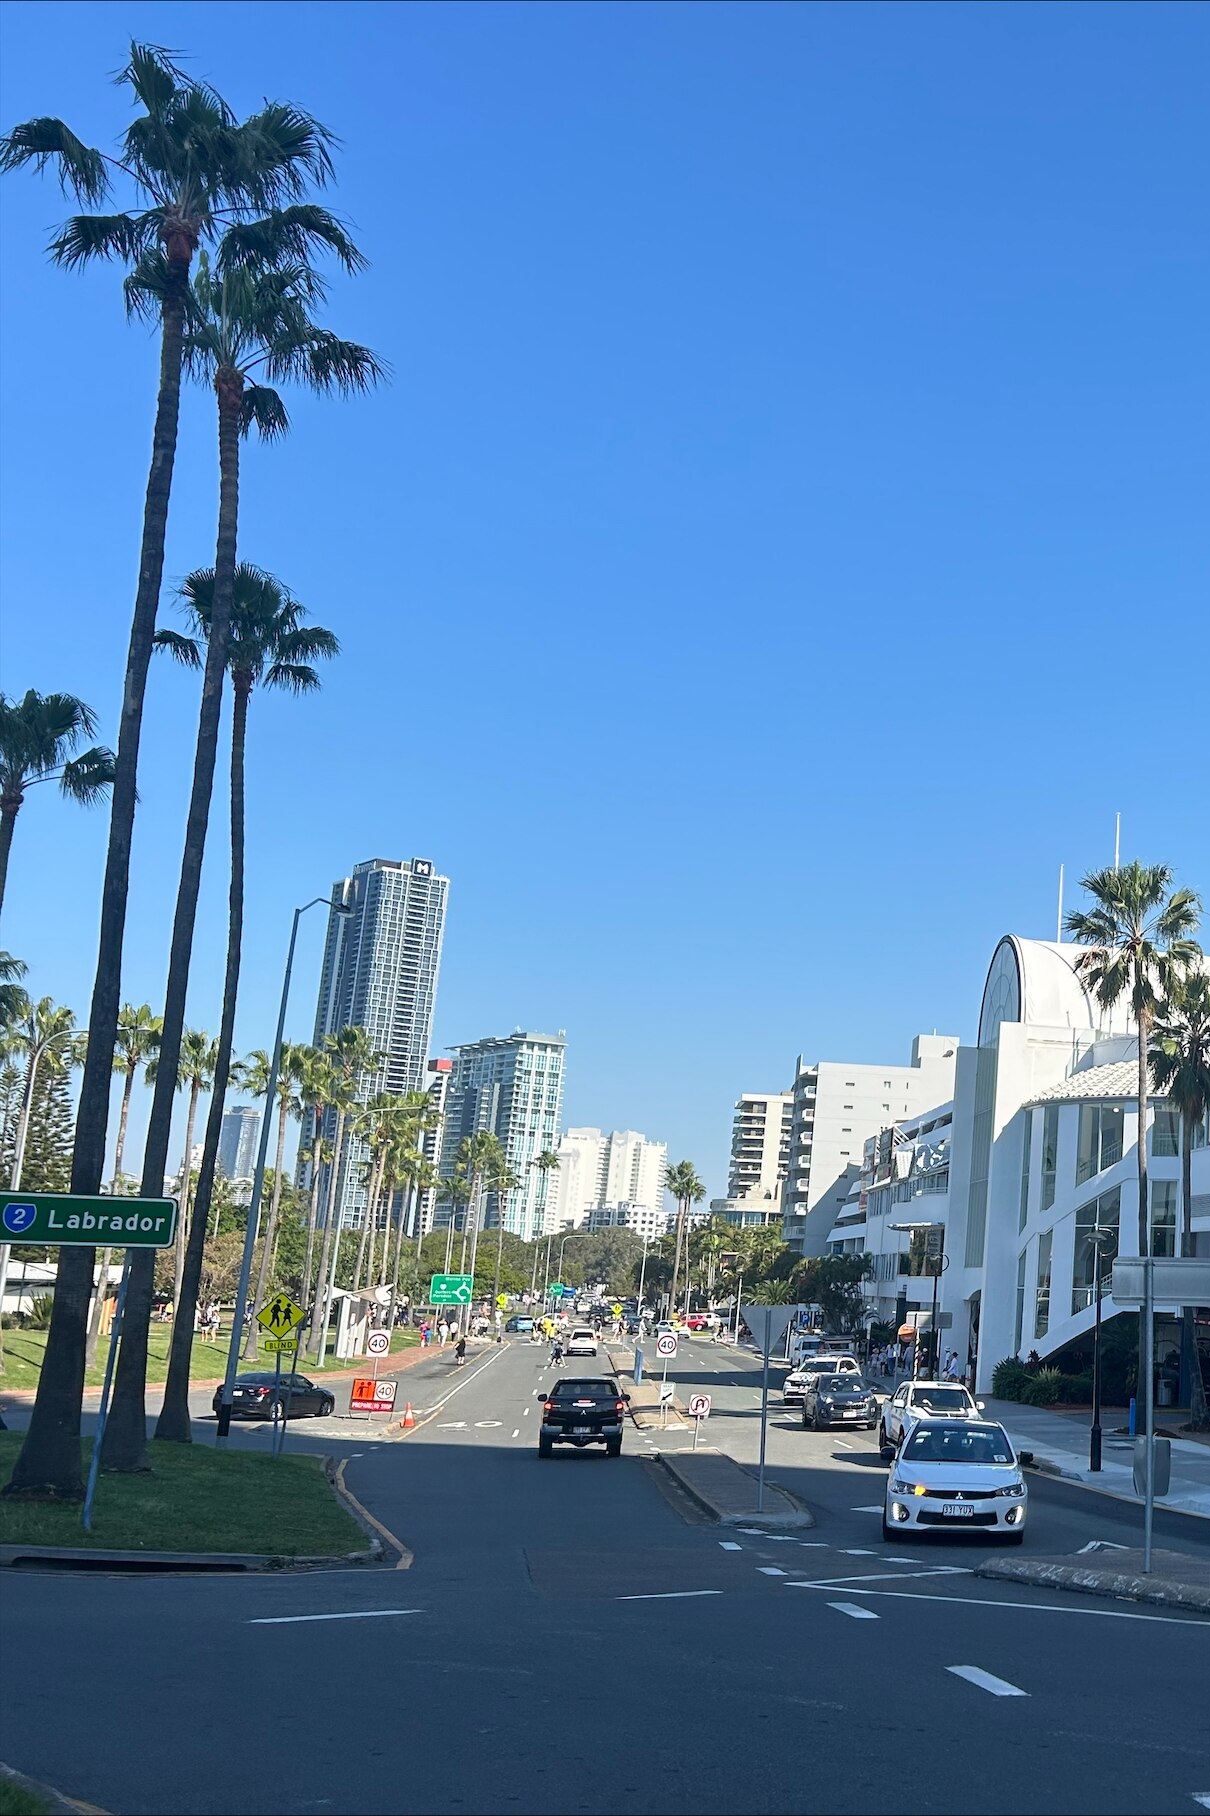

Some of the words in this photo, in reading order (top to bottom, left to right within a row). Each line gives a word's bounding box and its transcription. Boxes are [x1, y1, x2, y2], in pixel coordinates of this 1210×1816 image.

[12, 1208, 27, 1225] 2
[48, 1209, 165, 1232] Labrador
[269, 1341, 293, 1349] BLIND
[371, 1339, 386, 1348] 40
[661, 1340, 674, 1349] 40
[378, 1386, 392, 1396] 40
[437, 1420, 503, 1428] 40
